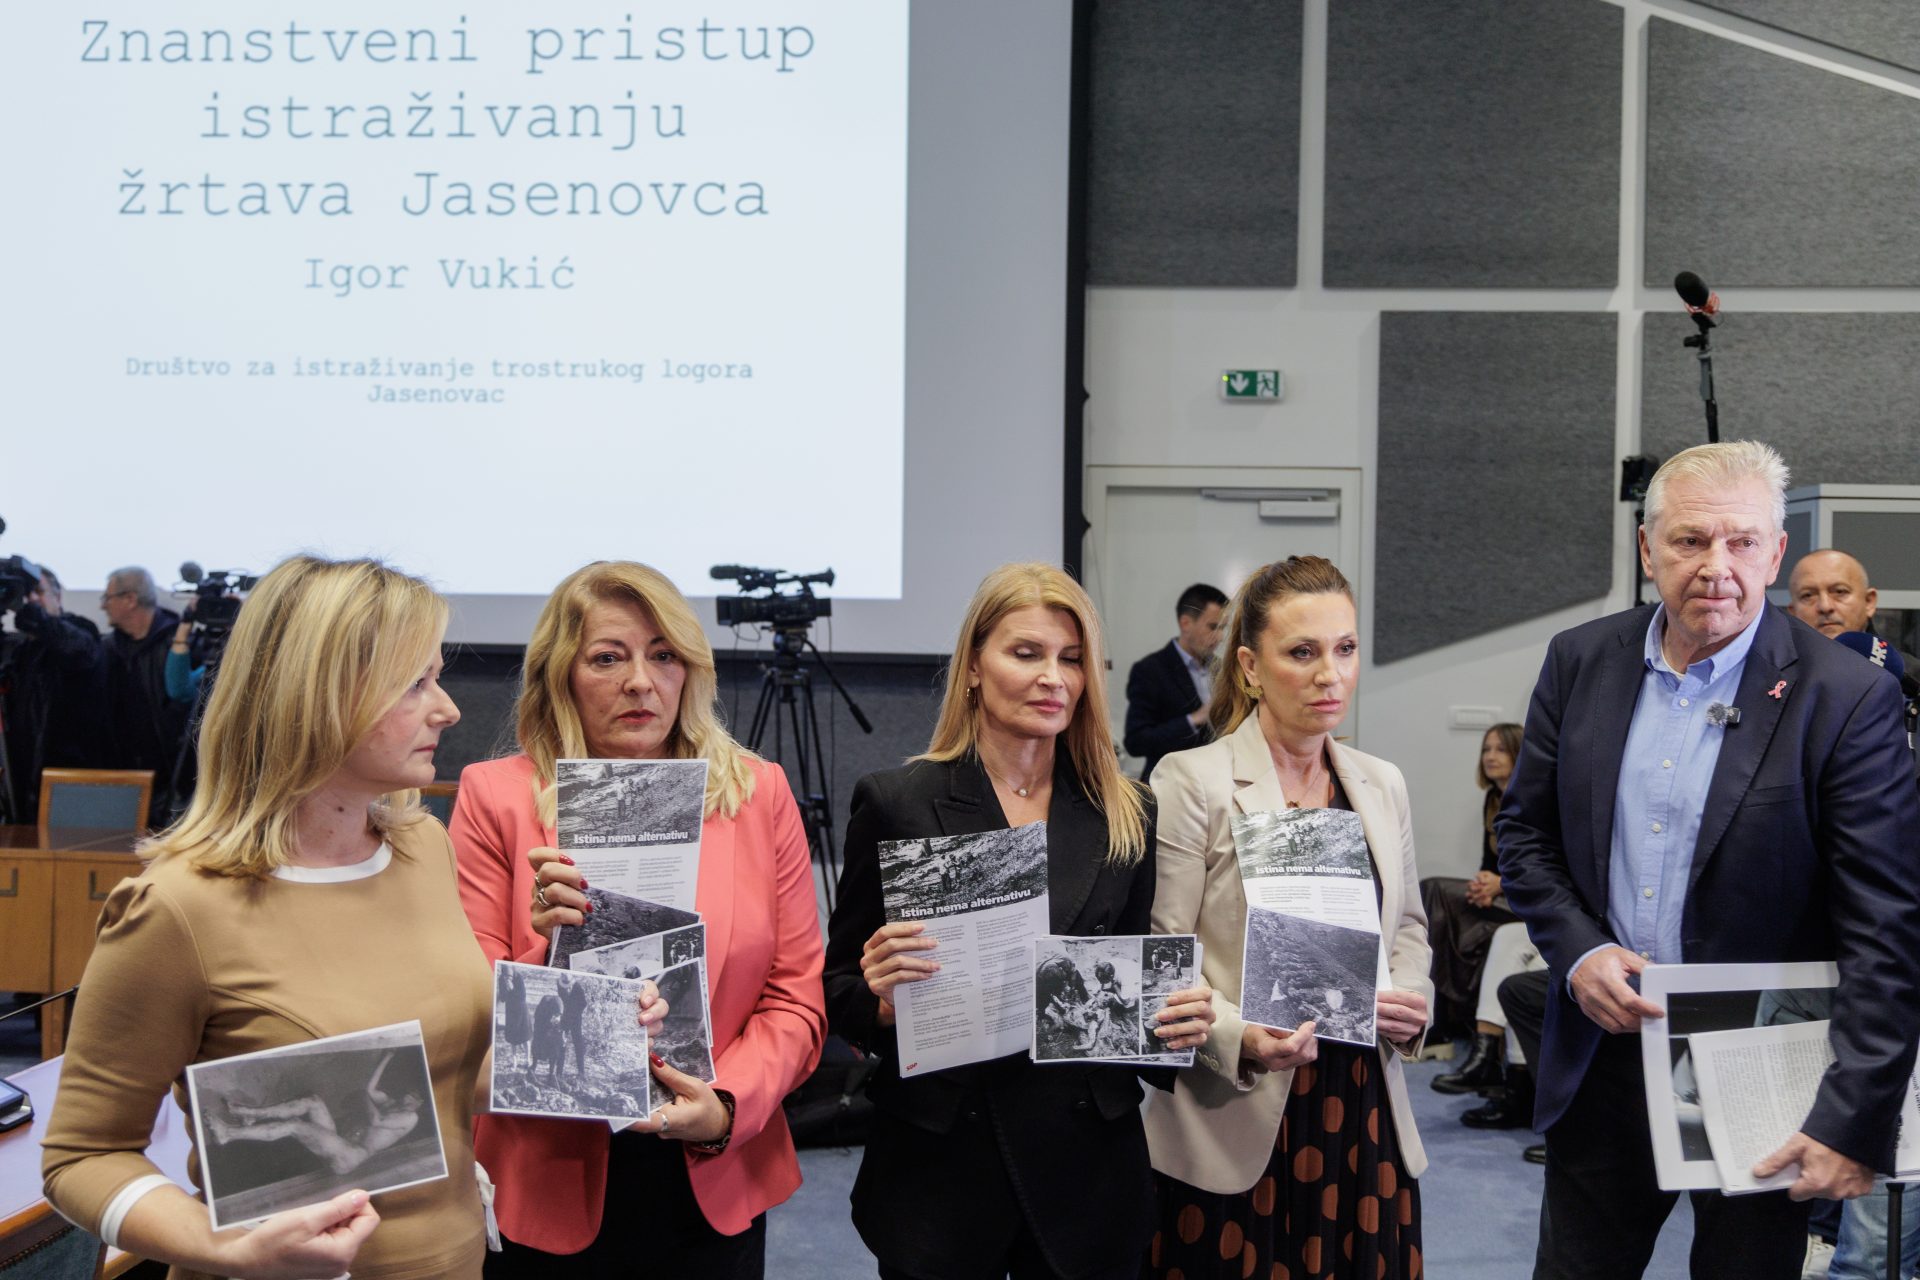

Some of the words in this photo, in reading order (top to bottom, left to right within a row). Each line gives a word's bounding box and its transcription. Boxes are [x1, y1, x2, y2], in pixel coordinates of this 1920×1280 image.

[81, 15, 478, 63] Znanstveni
[526, 13, 815, 75] pristup
[199, 90, 687, 152] istraživanju
[118, 168, 353, 217] žrtava
[402, 172, 770, 217] Jasenovca
[306, 259, 409, 297] Igor
[438, 256, 575, 290] Vukić
[126, 357, 231, 376] Društvo
[247, 361, 276, 376] za
[294, 358, 475, 383] istraživanje
[491, 359, 645, 384] trostrukog
[662, 358, 753, 384] logora
[367, 385, 505, 404] Jasenovac
[574, 833, 606, 845] Istina
[607, 832, 637, 844] nema
[638, 829, 689, 842] alternativu
[1255, 865, 1285, 875] Istina
[1286, 865, 1313, 874] nema
[1314, 864, 1362, 876] alternativu
[901, 906, 934, 918] Istina
[936, 903, 969, 914] nema
[970, 888, 1031, 909] alternativu
